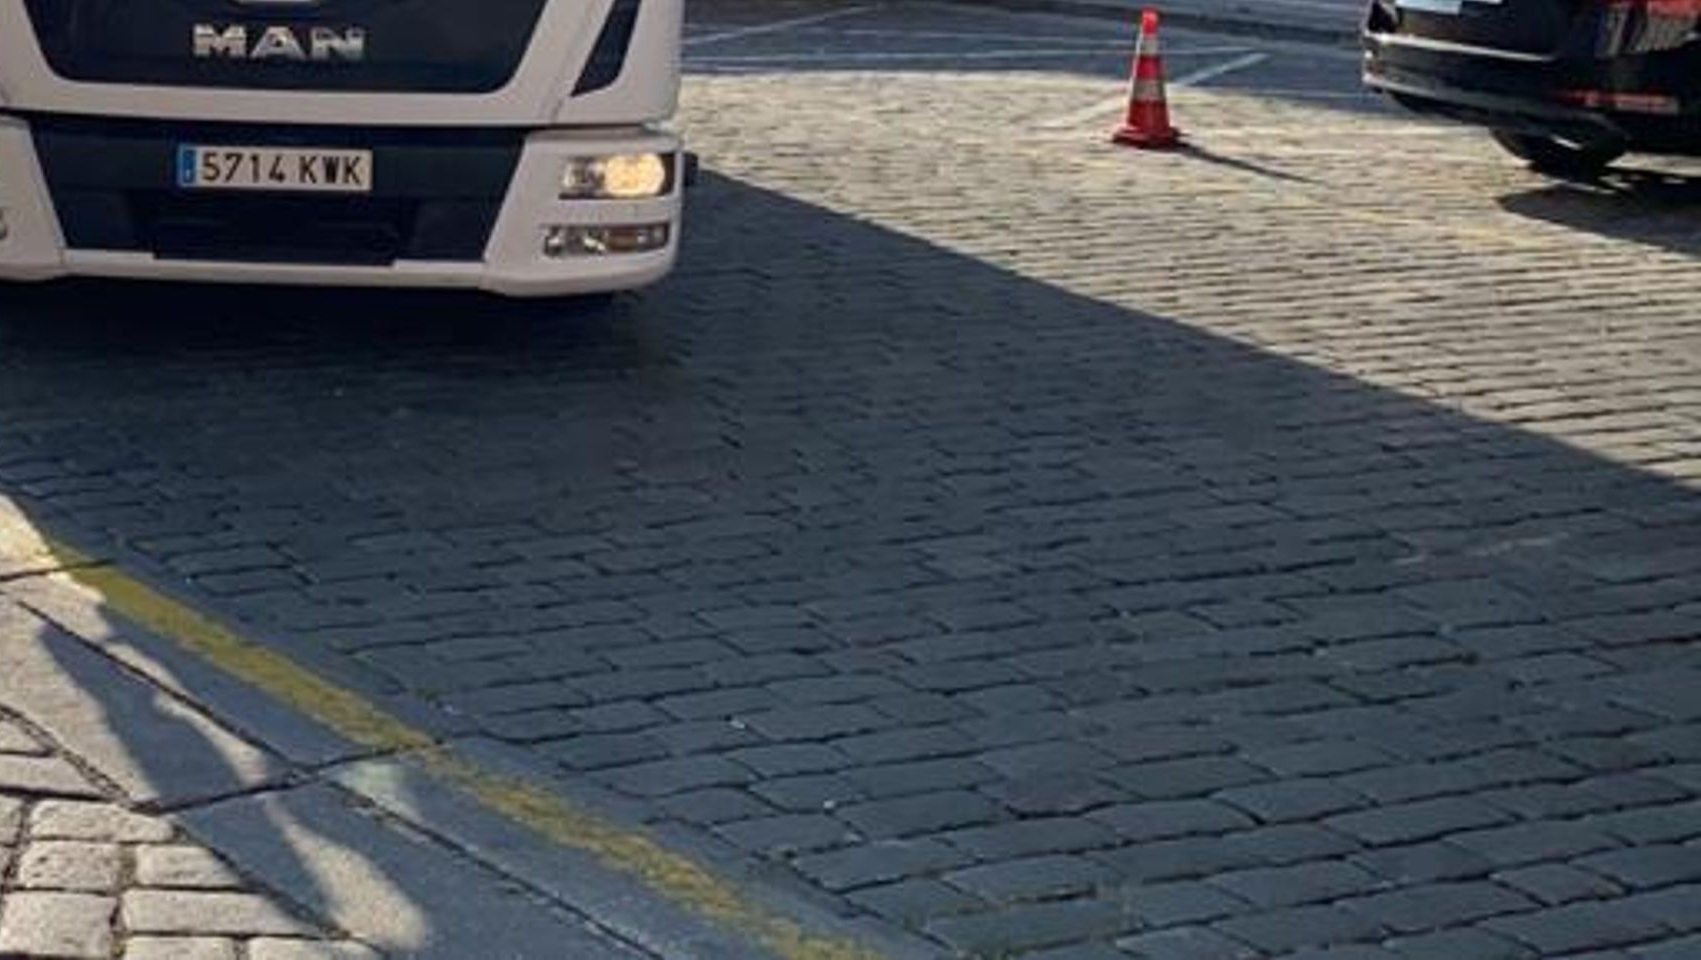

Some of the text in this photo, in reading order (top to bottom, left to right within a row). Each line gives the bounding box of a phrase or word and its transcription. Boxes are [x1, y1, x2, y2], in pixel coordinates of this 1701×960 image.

[192, 24, 366, 60] MAN
[201, 151, 362, 186] 5714 KWK
